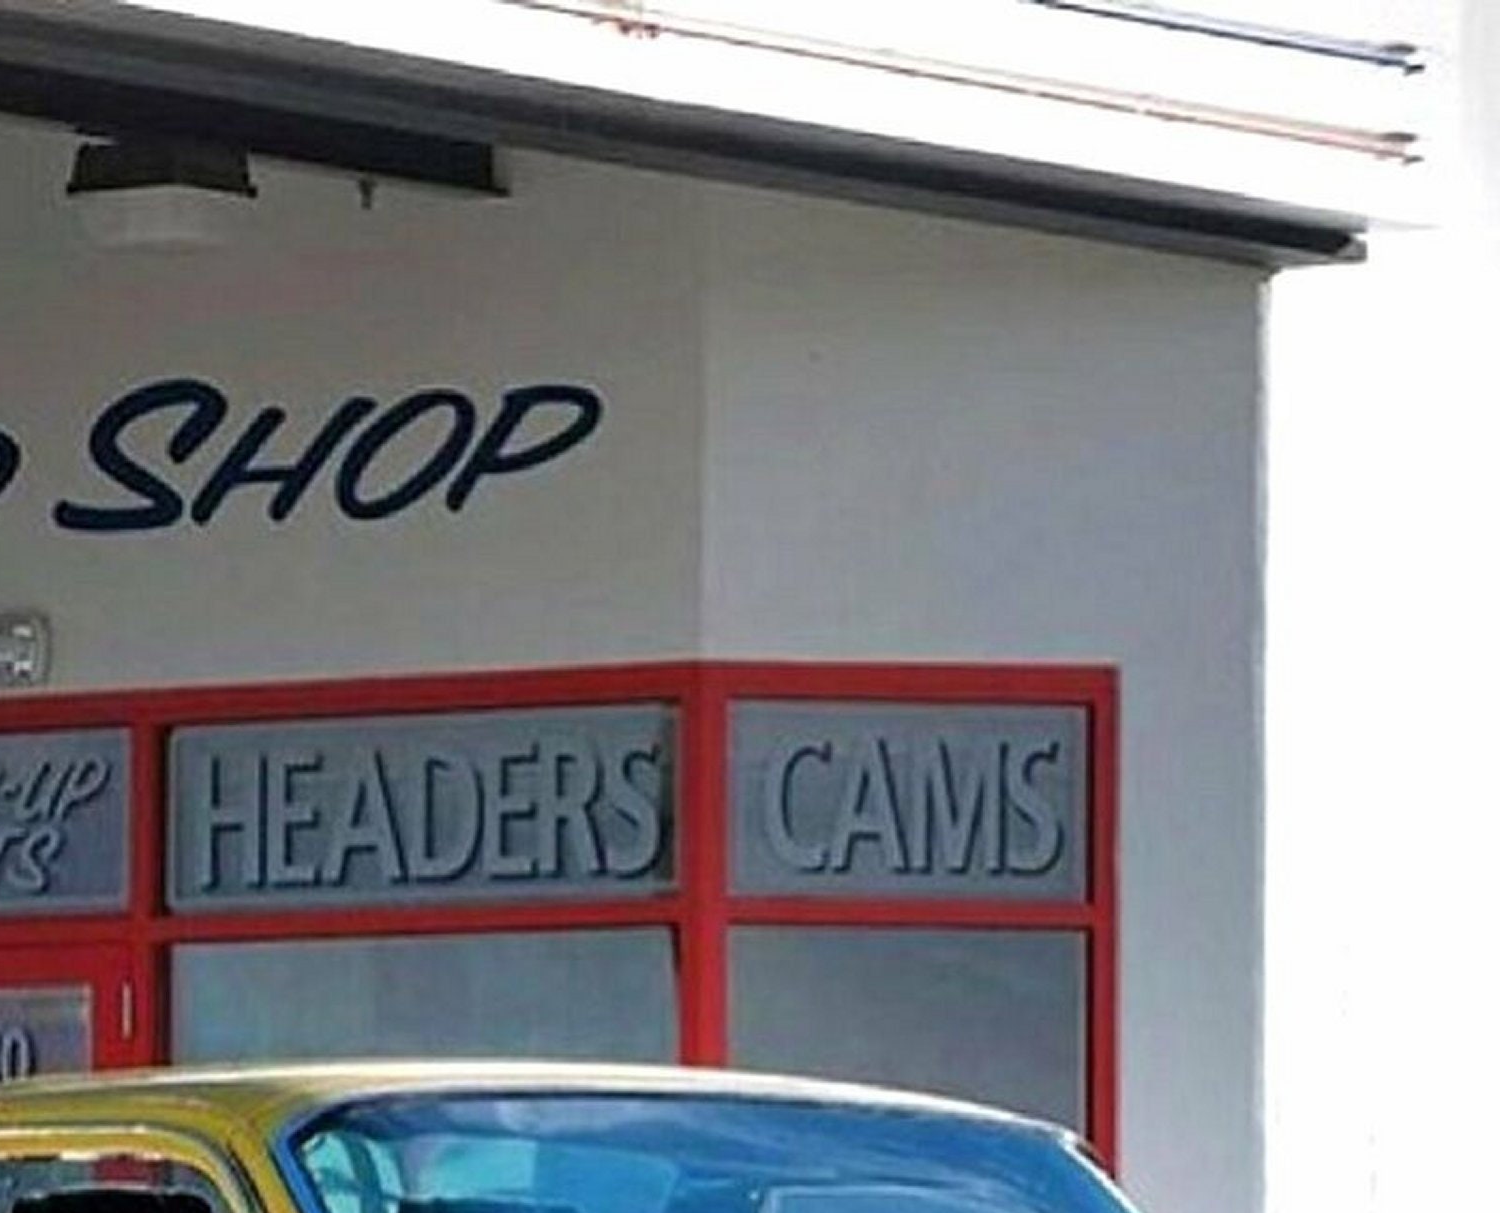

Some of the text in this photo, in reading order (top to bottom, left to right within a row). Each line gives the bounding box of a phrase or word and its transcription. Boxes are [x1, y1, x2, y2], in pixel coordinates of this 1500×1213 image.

[53, 377, 604, 534] SHOP
[200, 738, 666, 893] HEADERS
[764, 734, 1066, 878] CAMS
